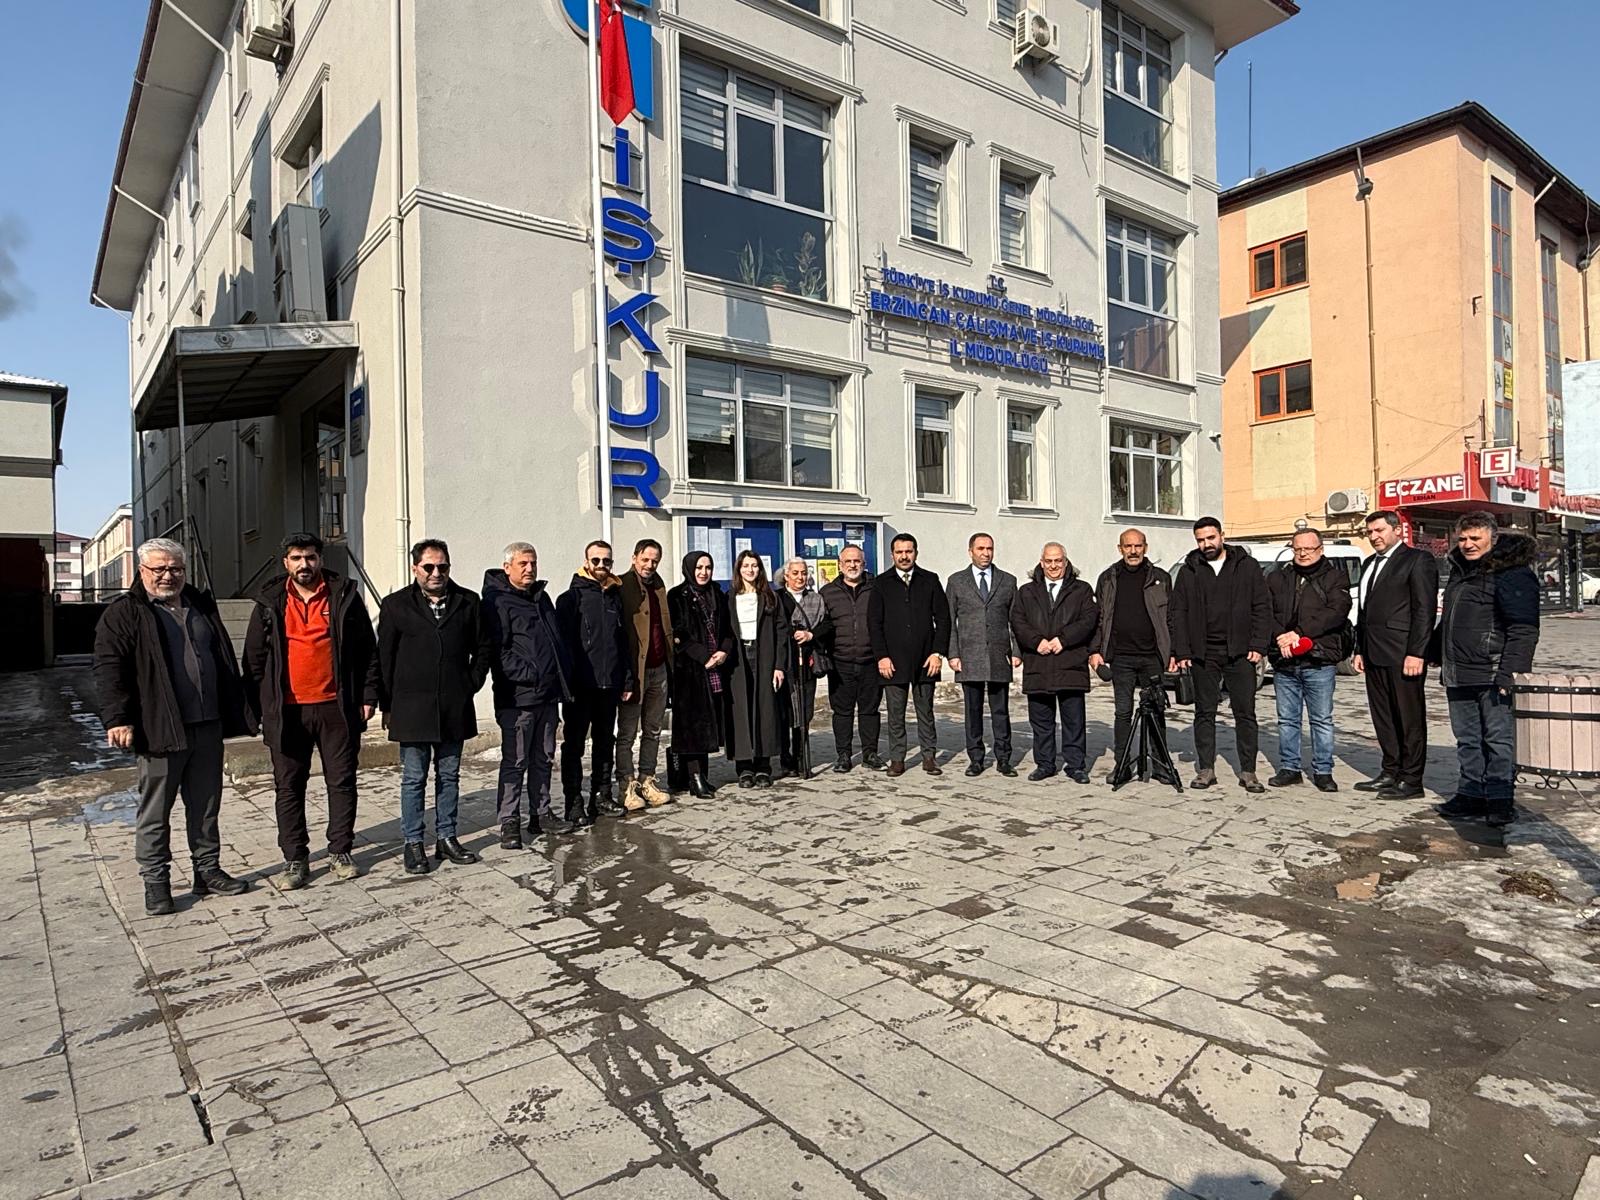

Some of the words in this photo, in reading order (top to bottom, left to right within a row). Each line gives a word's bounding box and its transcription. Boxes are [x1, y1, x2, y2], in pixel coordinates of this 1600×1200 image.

[881, 267, 936, 294] TÜRKİYE
[938, 279, 950, 299] İŞ
[952, 285, 1000, 310] KURUMU
[1001, 298, 1034, 318] GENEL
[598, 126, 662, 507] İŞKUR
[870, 291, 951, 325] ERZİNCAN
[955, 311, 1021, 341] ÇALIŞMA
[1020, 326, 1038, 345] VE
[1041, 328, 1053, 349] İŞ
[1056, 334, 1105, 359] KURUMU
[950, 338, 962, 357] İL
[1490, 453, 1505, 472] E
[1384, 474, 1464, 498] ECZANE
